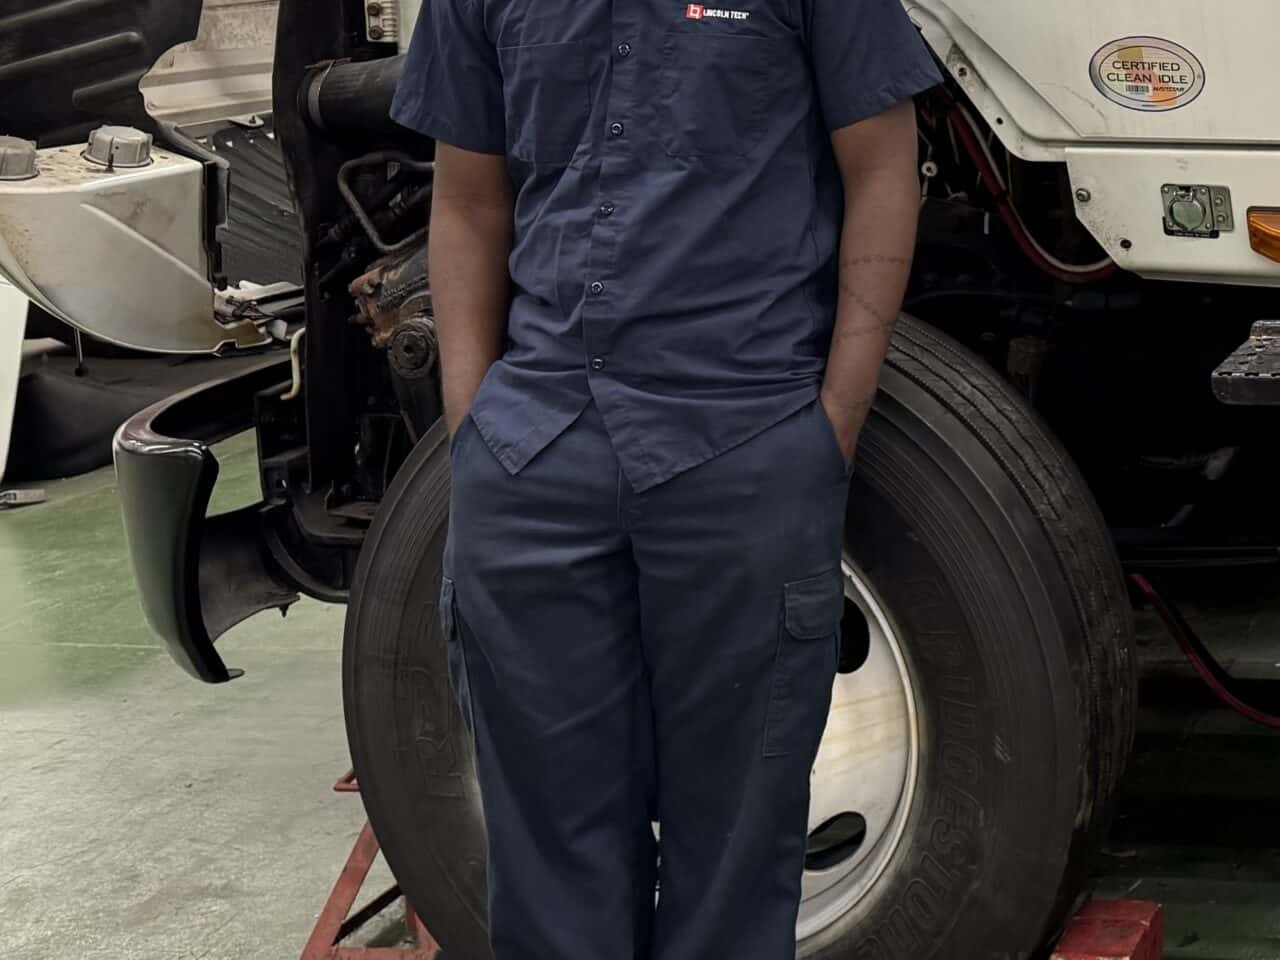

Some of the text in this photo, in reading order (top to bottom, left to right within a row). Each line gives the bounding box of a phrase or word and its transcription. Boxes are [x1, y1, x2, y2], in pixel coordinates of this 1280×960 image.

[1112, 60, 1181, 72] CERTIFIED
[1106, 72, 1189, 84] CLEAN IDLE
